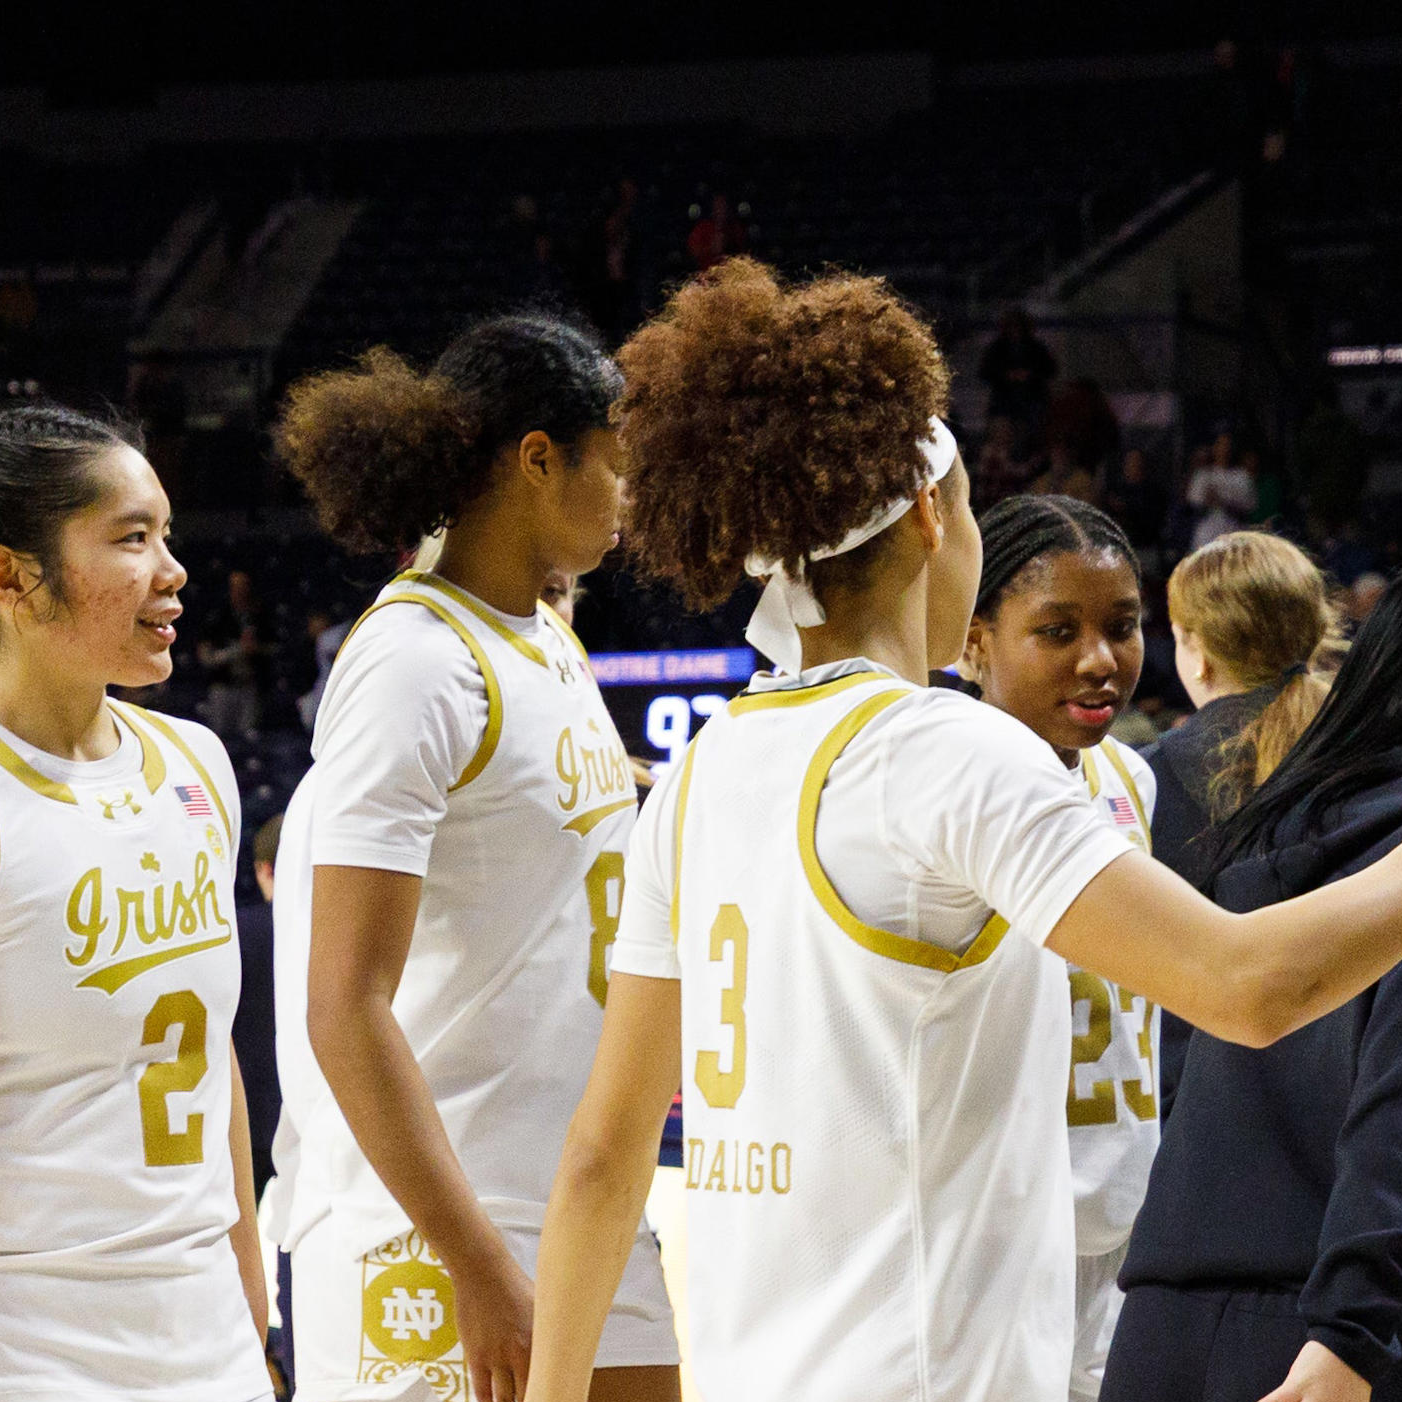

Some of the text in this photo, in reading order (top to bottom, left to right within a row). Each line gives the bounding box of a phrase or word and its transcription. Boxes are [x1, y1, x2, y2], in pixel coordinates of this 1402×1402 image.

[555, 725, 634, 812] Iris
[64, 850, 232, 968] Irish
[137, 988, 210, 1177] 2
[694, 903, 749, 1110] 3
[1066, 971, 1158, 1127] 23
